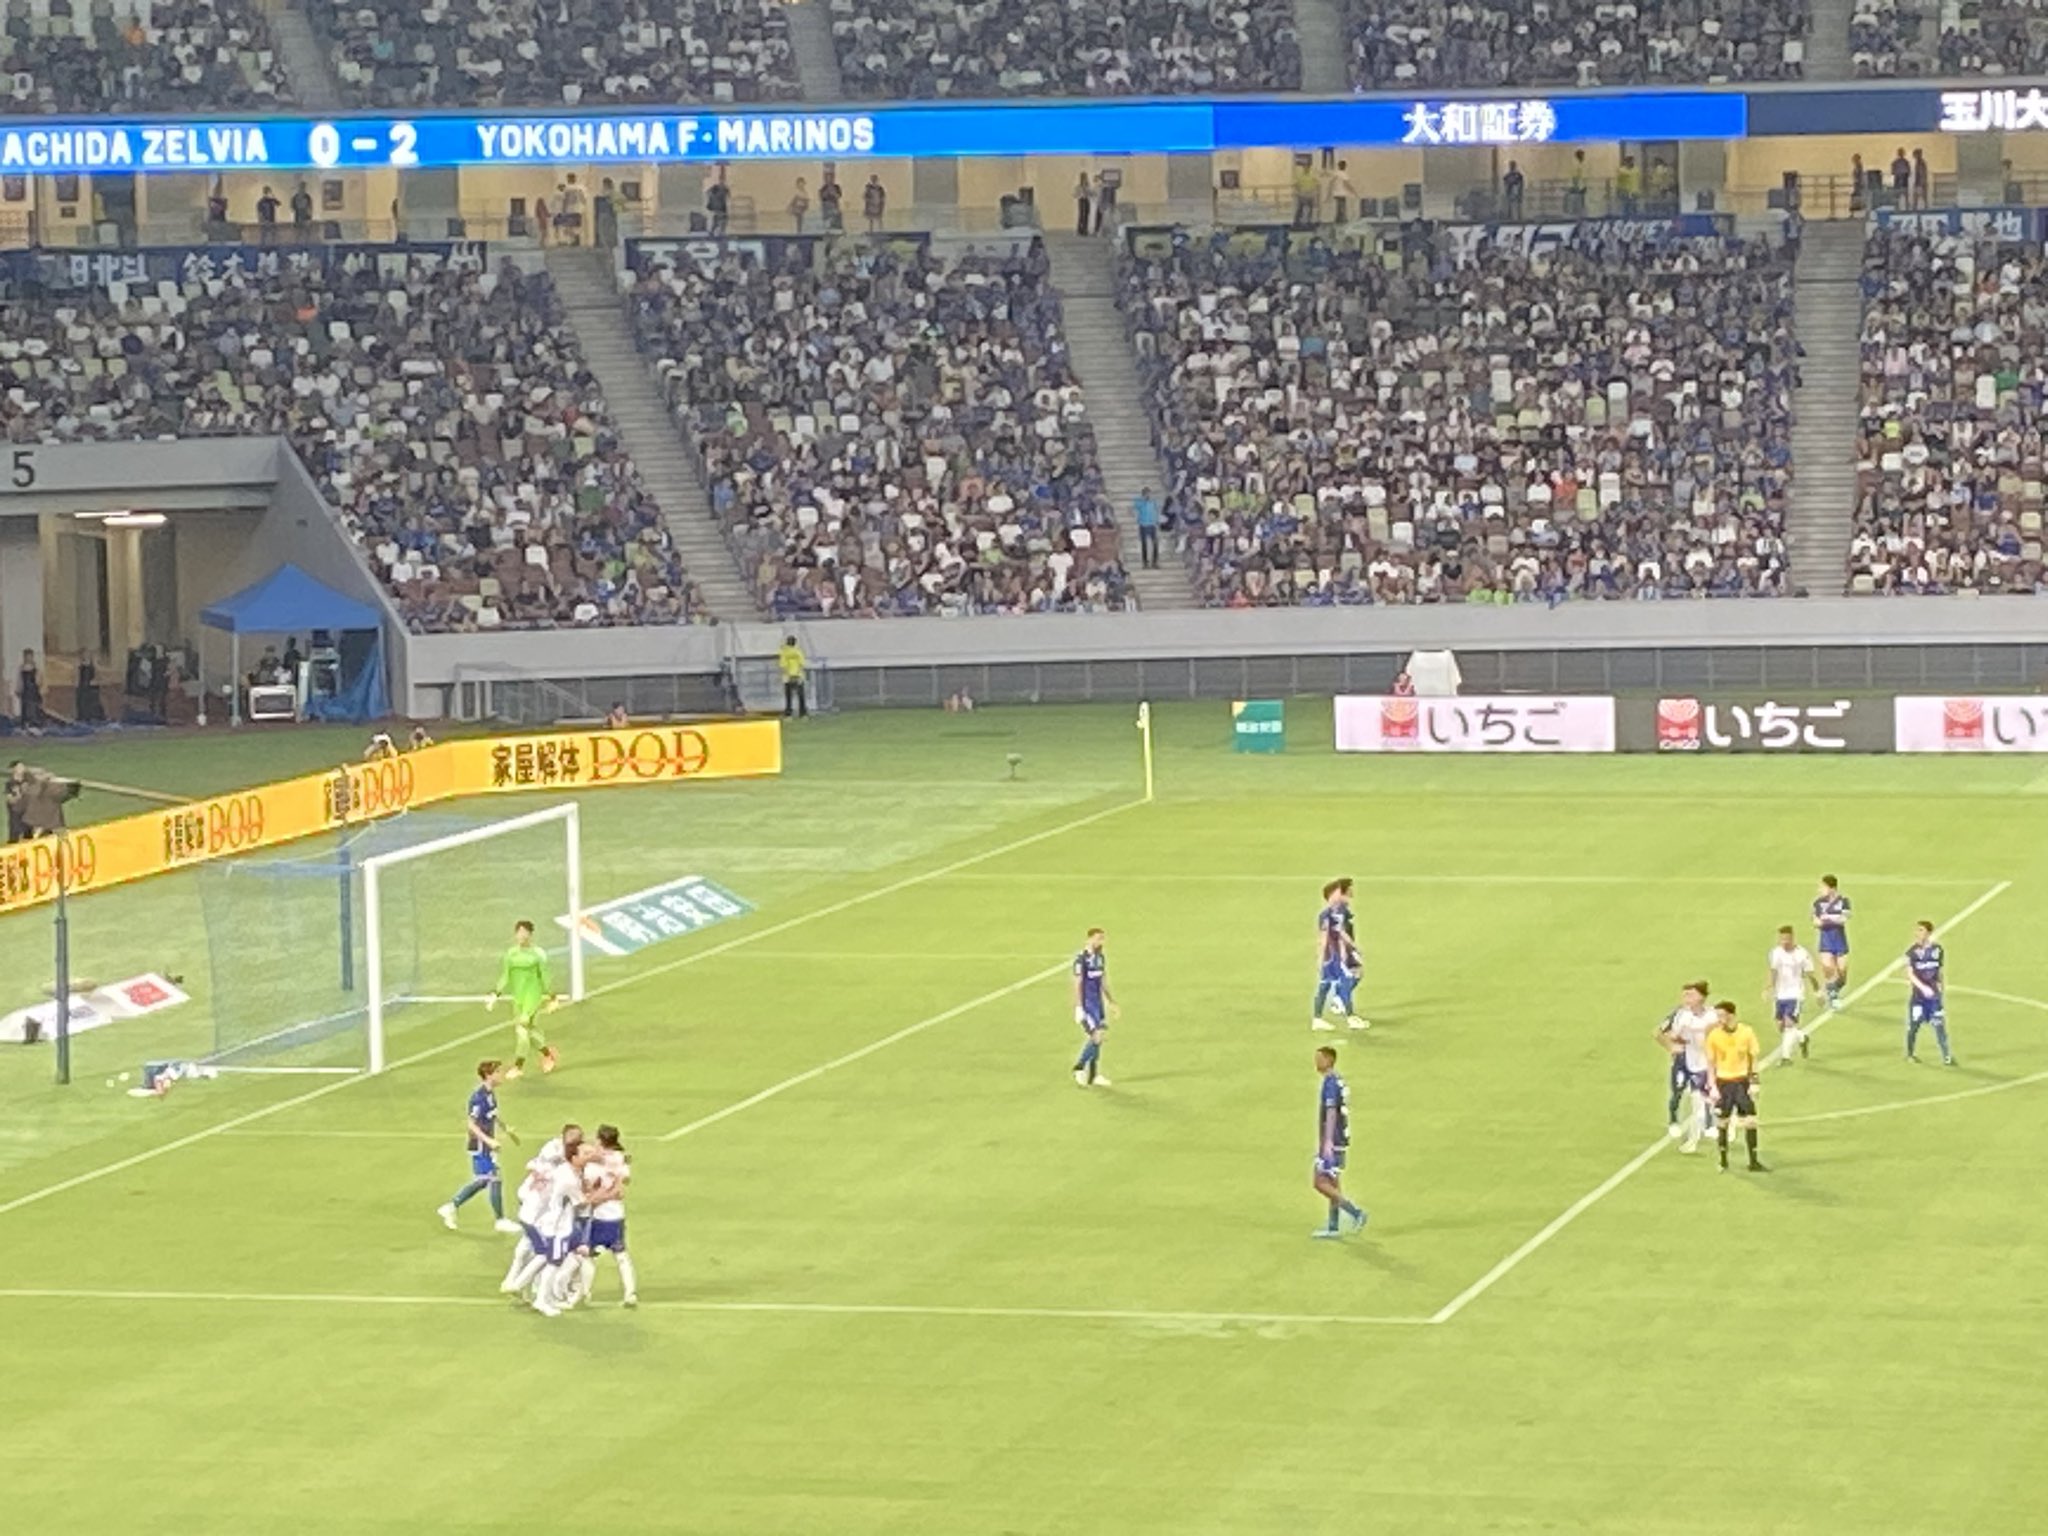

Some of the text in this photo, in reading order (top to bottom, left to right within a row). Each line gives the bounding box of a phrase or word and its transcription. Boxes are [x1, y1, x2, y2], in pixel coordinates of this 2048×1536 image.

[1402, 99, 1556, 144] 大和証券
[1940, 88, 2048, 131] 玉川大
[2, 126, 267, 166] ACHIDA ZELVIA
[390, 123, 418, 164] 2
[477, 121, 670, 159] YOKOHAMA
[11, 451, 36, 487] 5
[1427, 703, 1567, 746] いちご
[1705, 700, 1852, 748] いちご
[490, 730, 710, 787] 家屋解体 DOD
